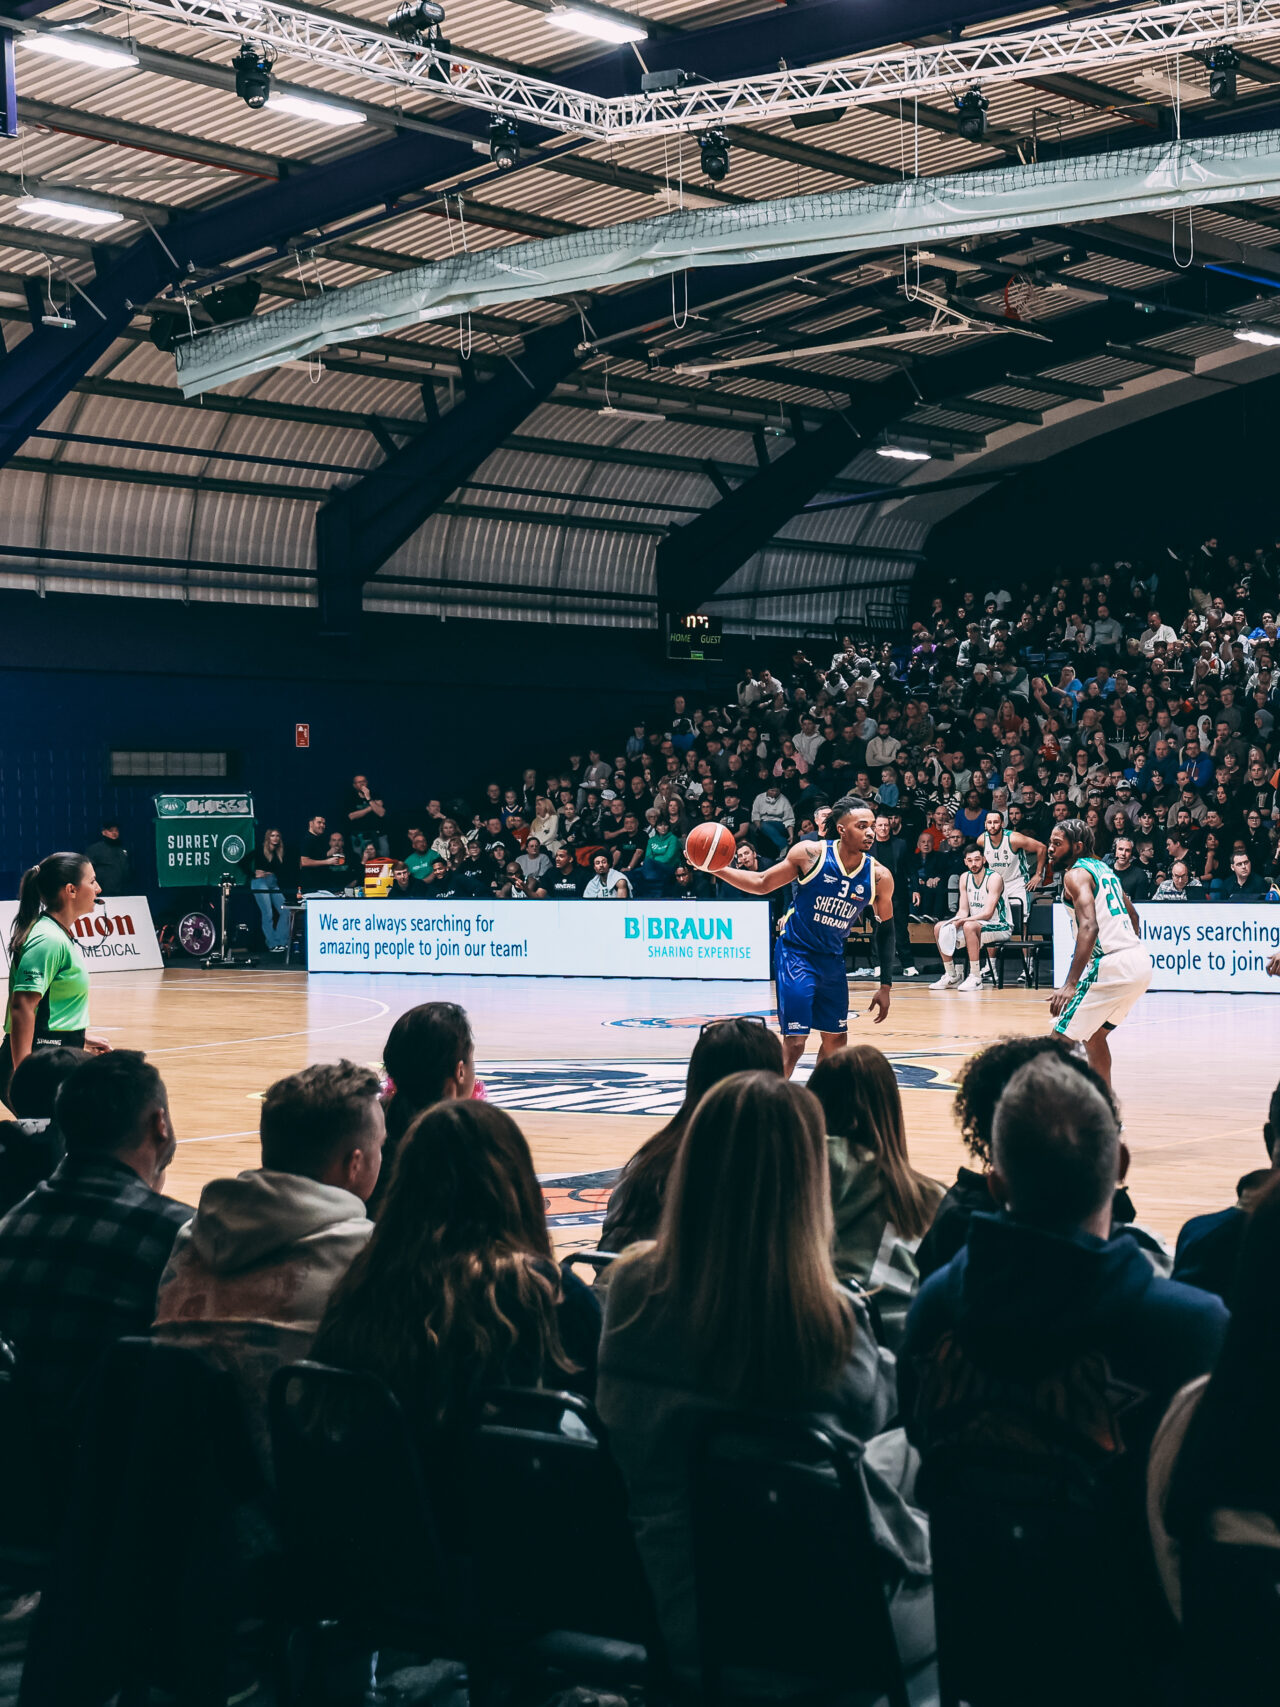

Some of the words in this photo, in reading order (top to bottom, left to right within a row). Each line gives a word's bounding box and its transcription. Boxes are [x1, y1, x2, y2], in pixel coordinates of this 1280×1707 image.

[670, 633, 692, 643] HOME
[700, 634, 721, 644] GUEST
[167, 834, 219, 849] SURREY
[168, 852, 210, 867] 89ERS
[993, 851, 1000, 861] 4
[837, 879, 850, 898] 3
[1102, 877, 1129, 916] 20
[813, 896, 858, 920] SHEFFIELD
[319, 913, 338, 931] We
[342, 917, 361, 931] are
[365, 914, 407, 935] always
[411, 914, 471, 936] searching
[476, 915, 494, 932] for
[647, 917, 733, 940] BRAUN
[821, 914, 849, 930] BRAUN
[1196, 920, 1280, 947] searching
[82, 943, 140, 959] MEDICAL
[319, 937, 370, 959] amazing
[374, 938, 415, 959] people
[419, 940, 432, 955] to
[435, 938, 460, 961] join
[464, 941, 486, 956] our
[490, 939, 528, 957] team!
[648, 945, 694, 958] SHARING
[698, 946, 752, 959] EXPERTISE
[1207, 951, 1226, 970] to
[1230, 950, 1264, 976] join
